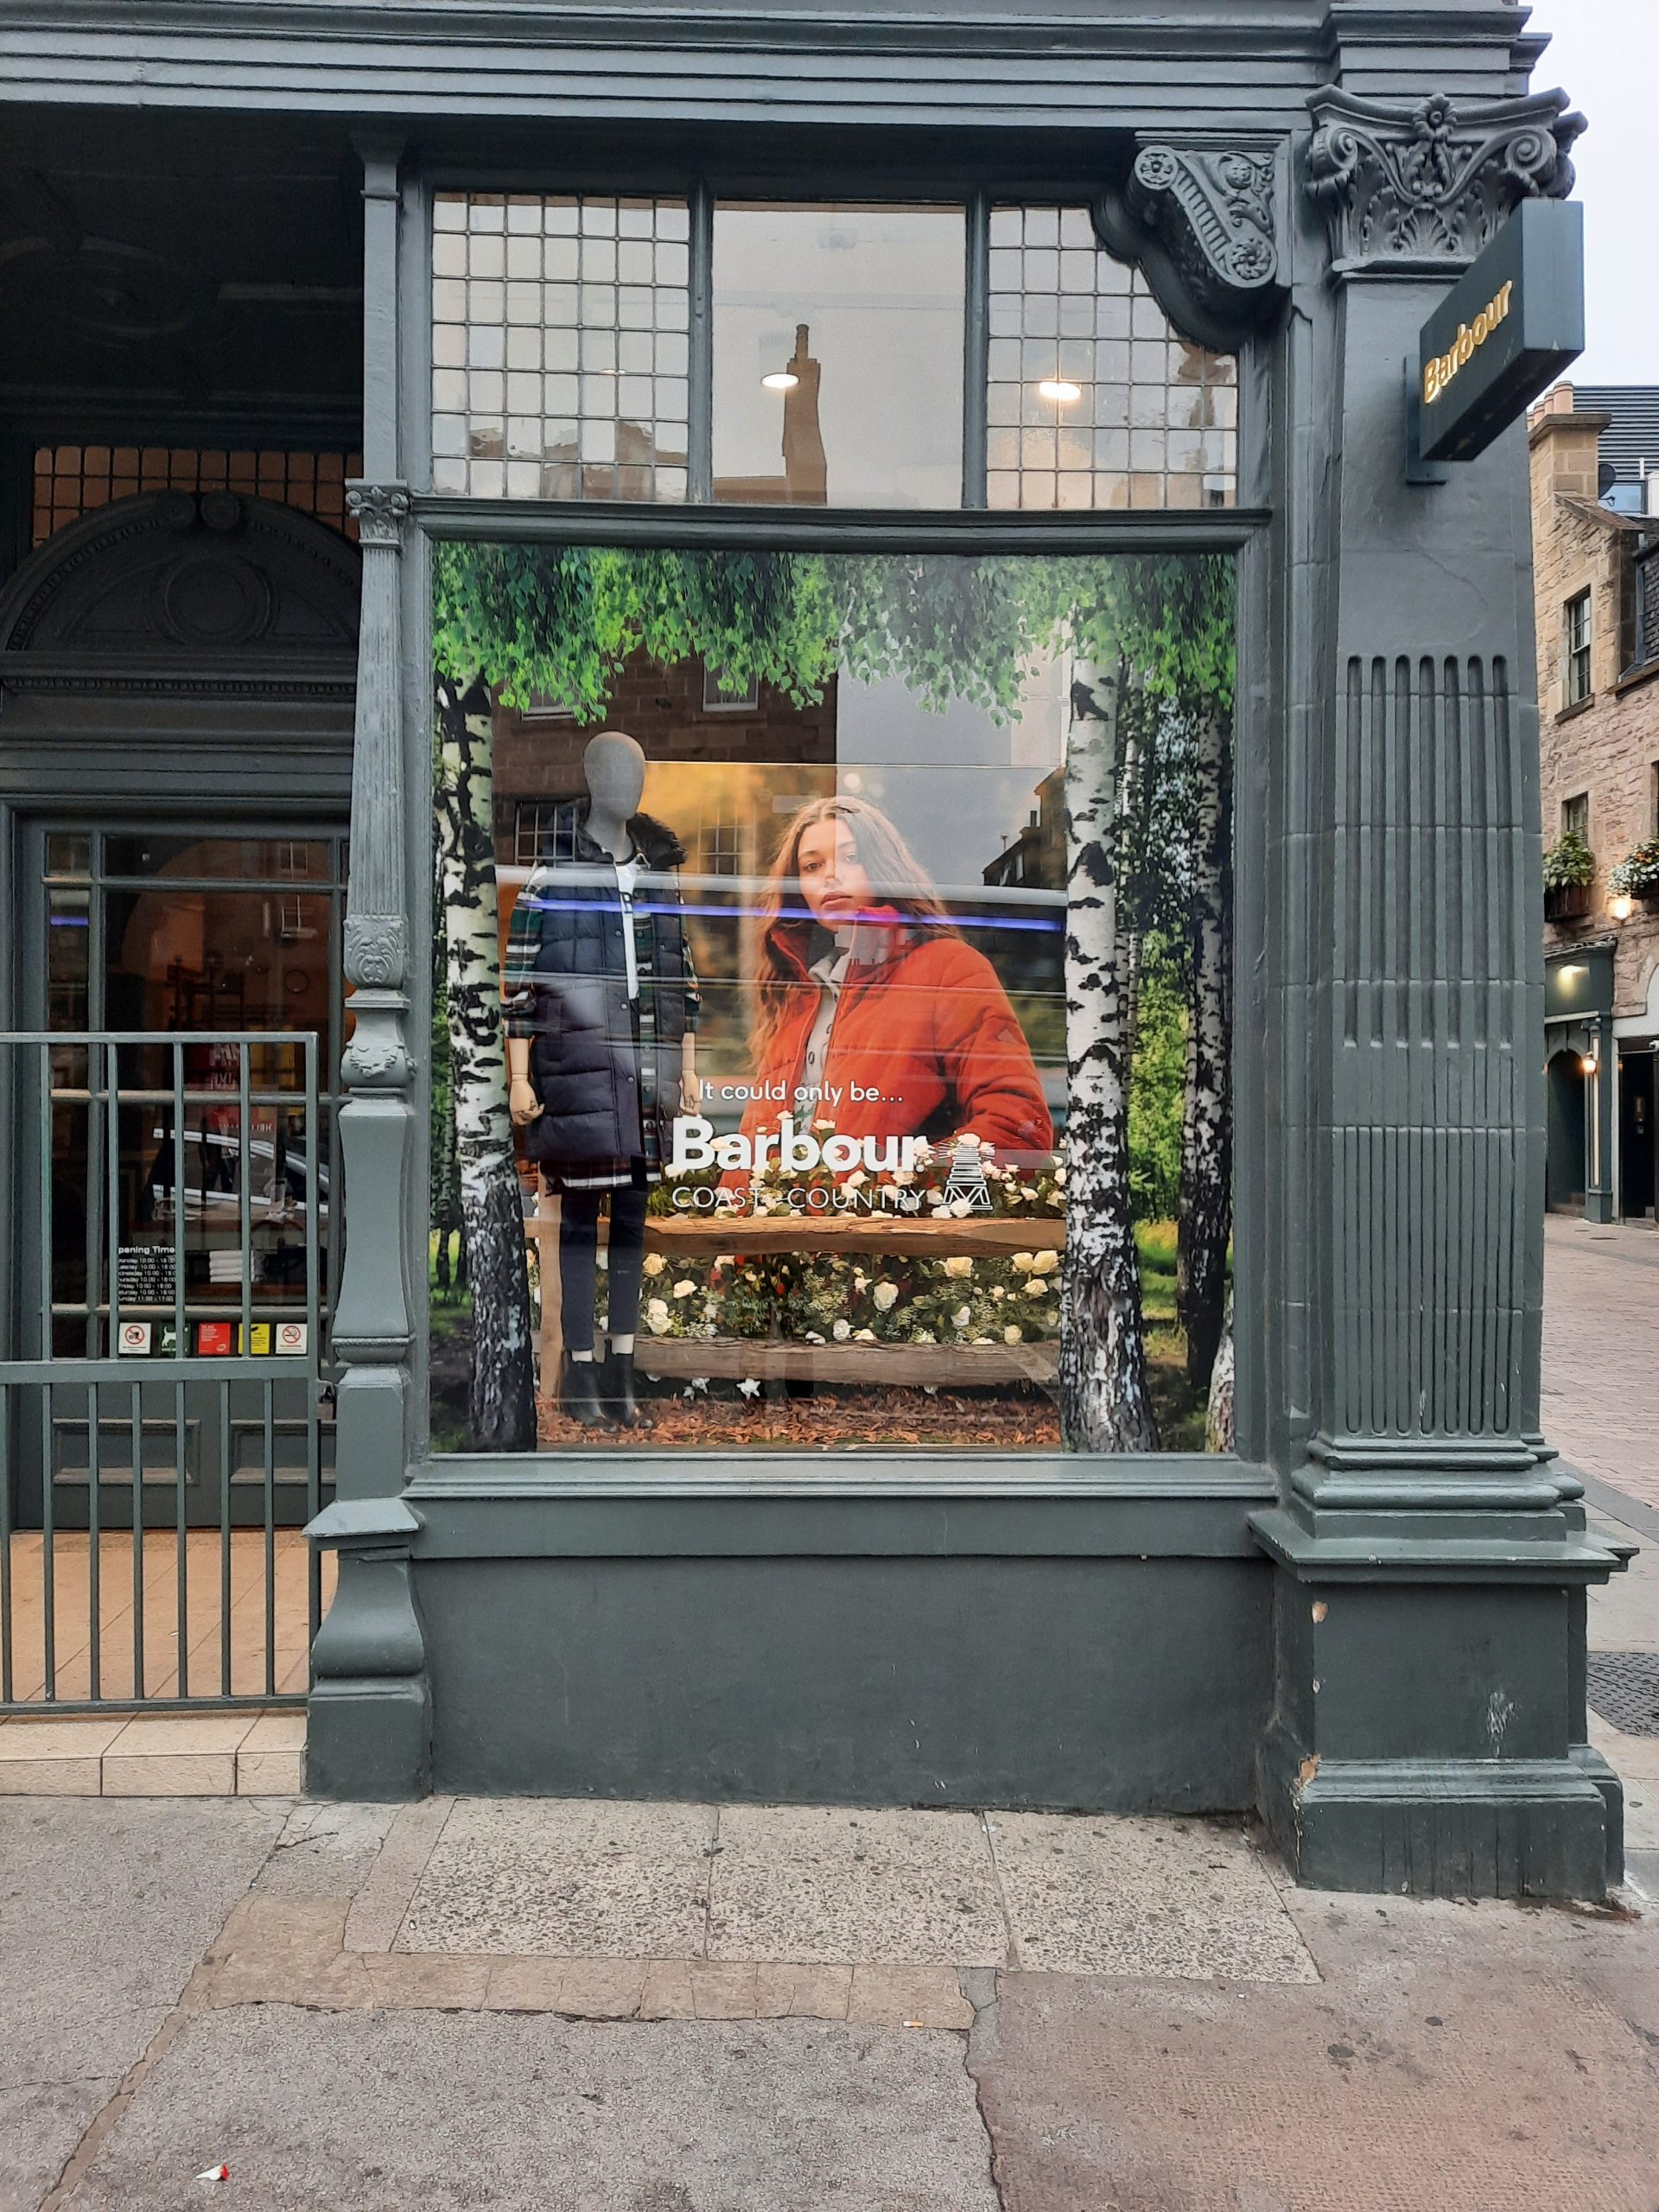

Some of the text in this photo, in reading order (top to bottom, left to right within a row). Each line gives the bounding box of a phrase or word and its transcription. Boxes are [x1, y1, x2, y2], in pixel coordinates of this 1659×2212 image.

[1424, 280, 1512, 404] Barbour
[698, 1079, 904, 1107] It could only be...
[672, 1116, 926, 1172] Barbour
[671, 1186, 762, 1209] COAST
[787, 1187, 926, 1210] COUNTRY
[118, 1245, 175, 1255] pening Time
